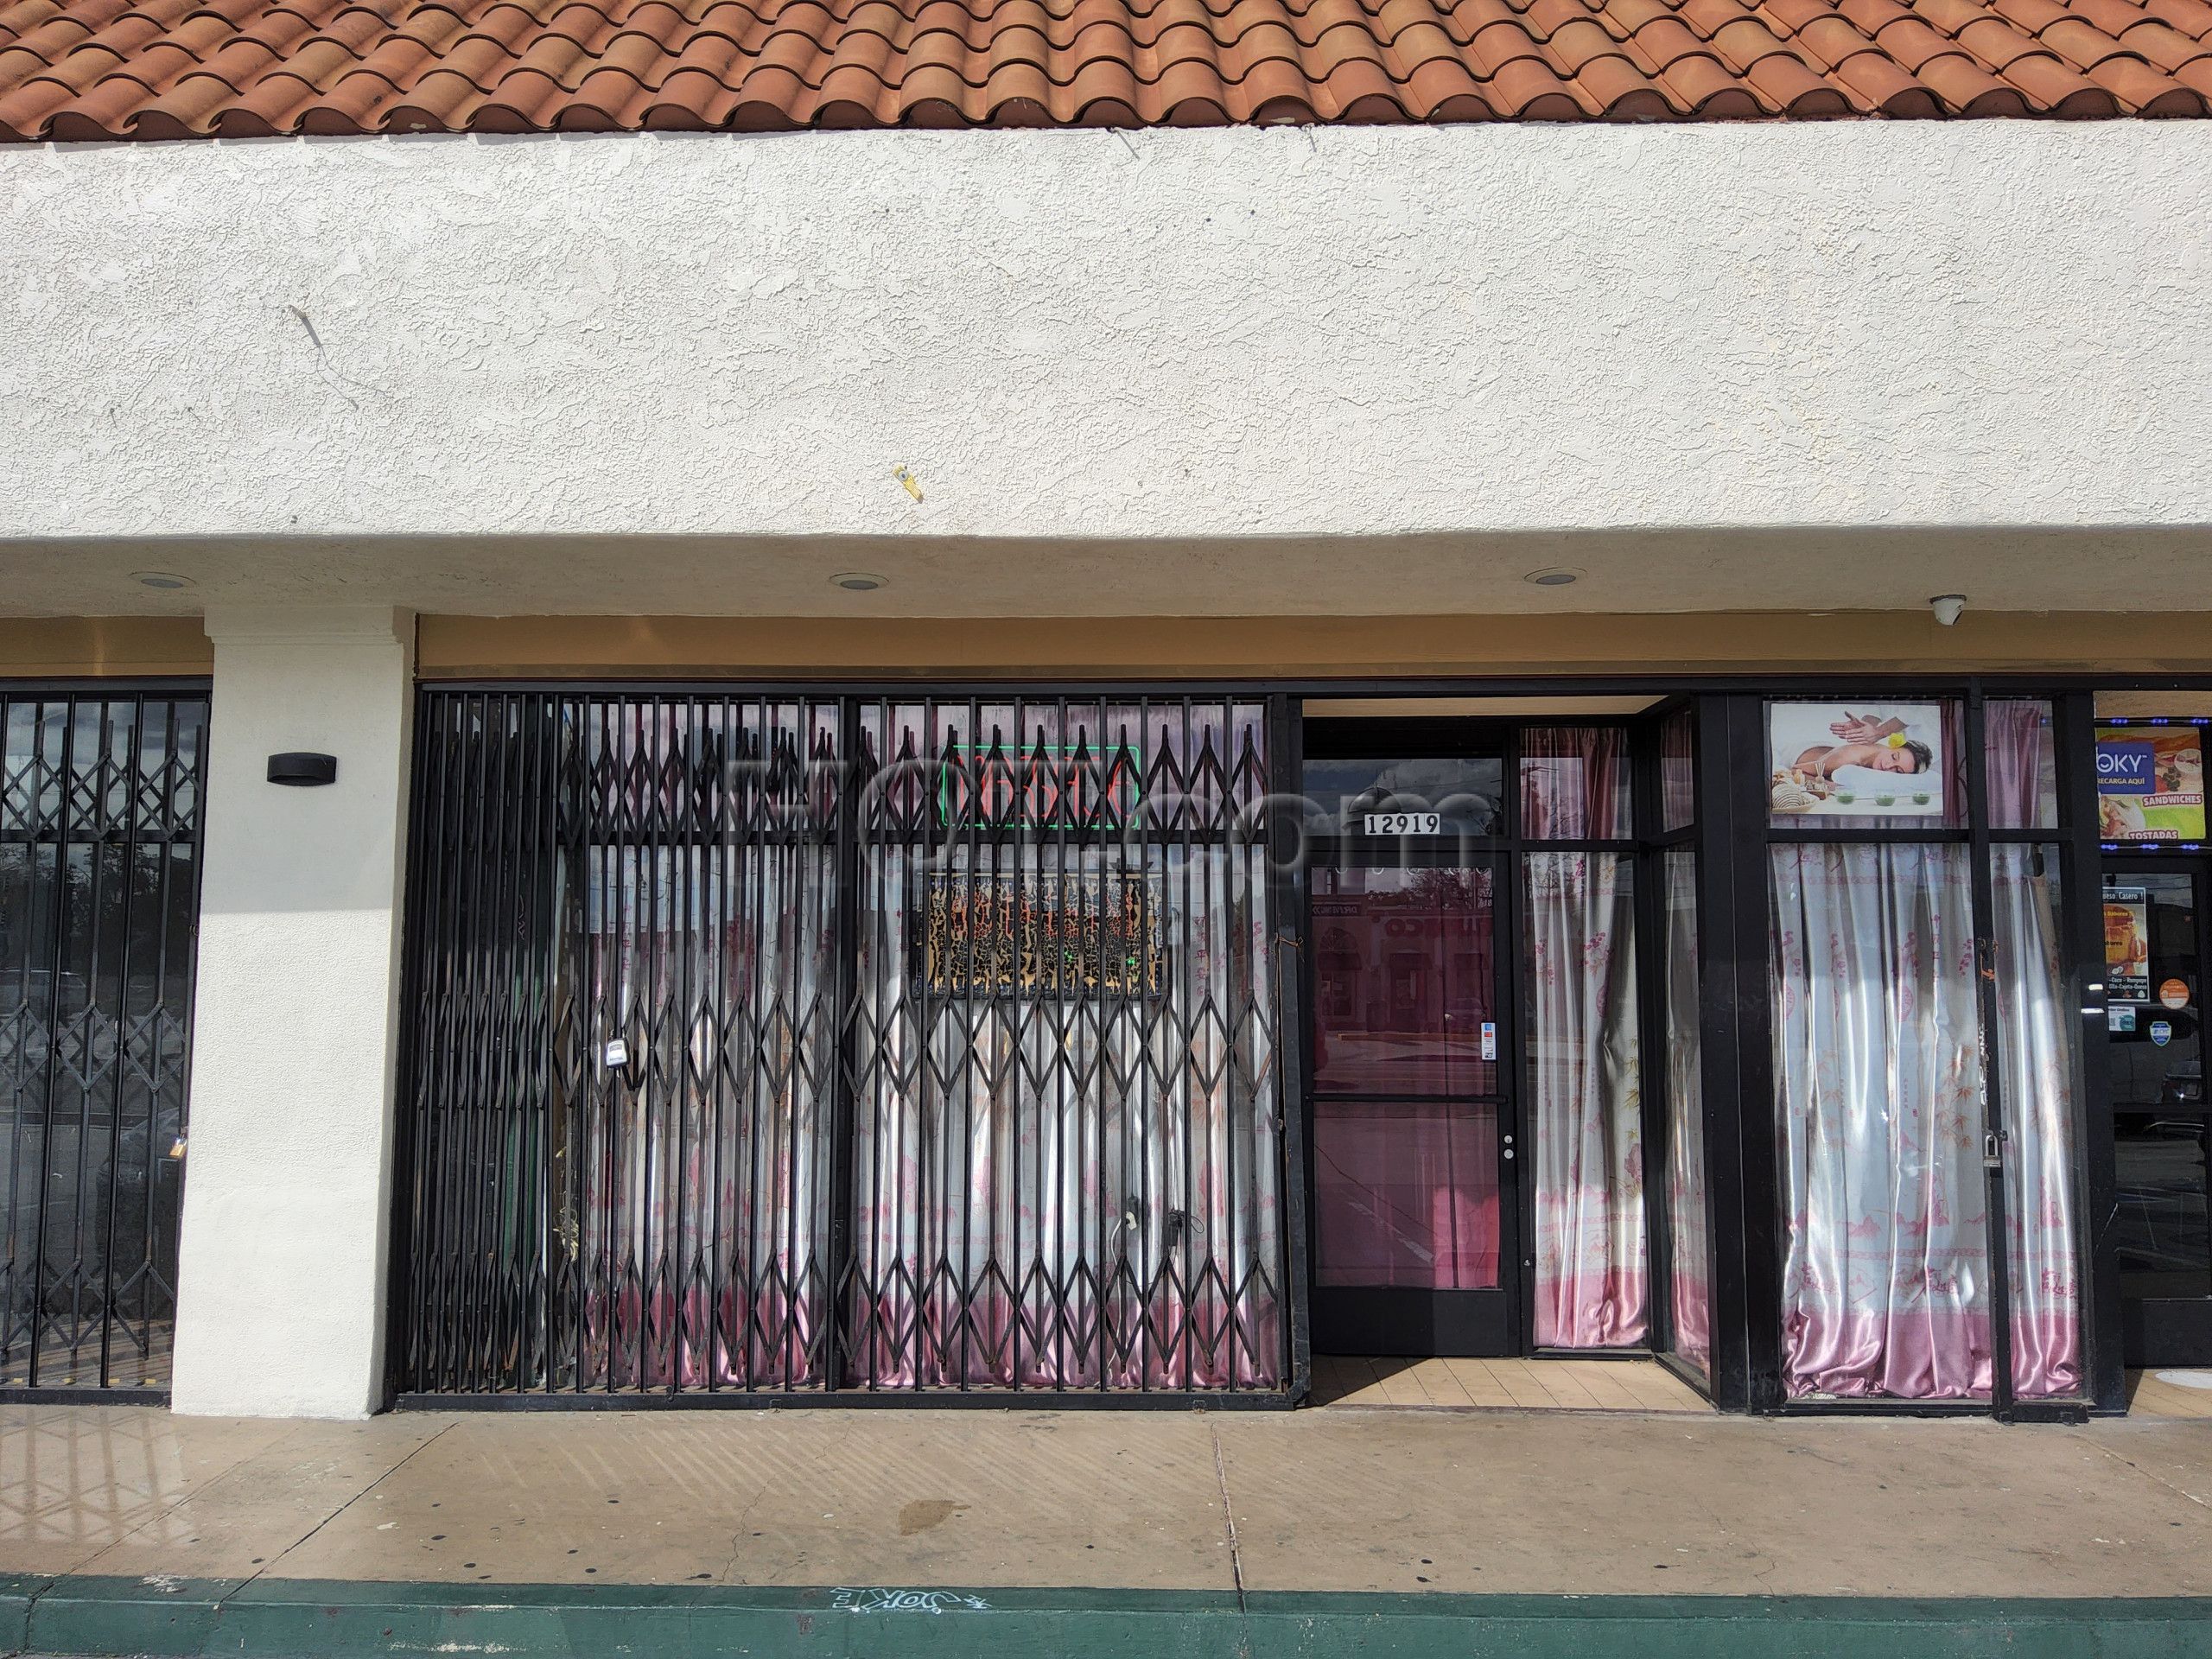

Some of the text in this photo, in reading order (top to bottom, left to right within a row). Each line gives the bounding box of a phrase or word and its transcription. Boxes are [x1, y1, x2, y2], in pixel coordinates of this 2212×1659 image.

[2143, 795, 2202, 806] SANDWICHES
[1368, 815, 1439, 835] 12919
[2130, 830, 2178, 840] TOSTADAS
